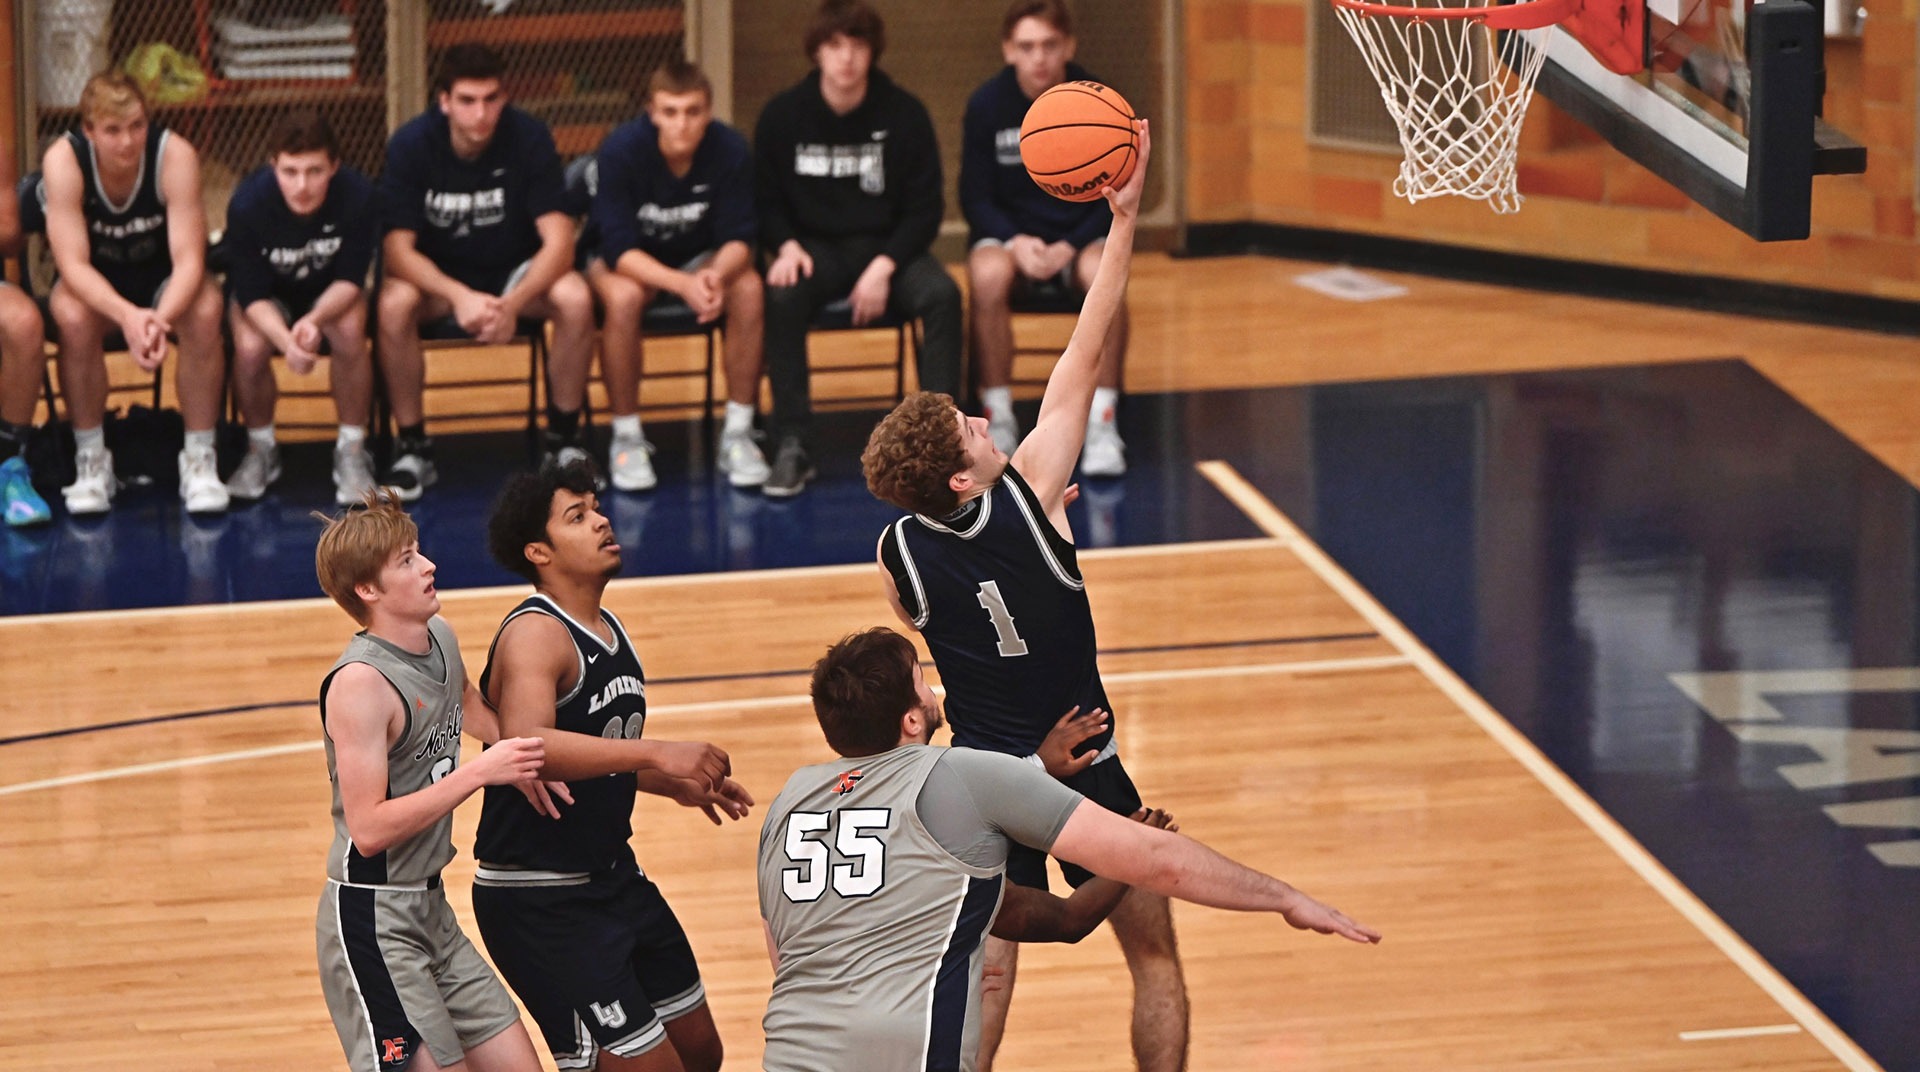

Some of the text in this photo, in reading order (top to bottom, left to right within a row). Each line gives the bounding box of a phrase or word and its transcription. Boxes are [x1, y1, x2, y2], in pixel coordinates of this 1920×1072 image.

[1036, 171, 1110, 196] Wilson
[976, 580, 1029, 657] 1
[782, 808, 892, 904] 55
